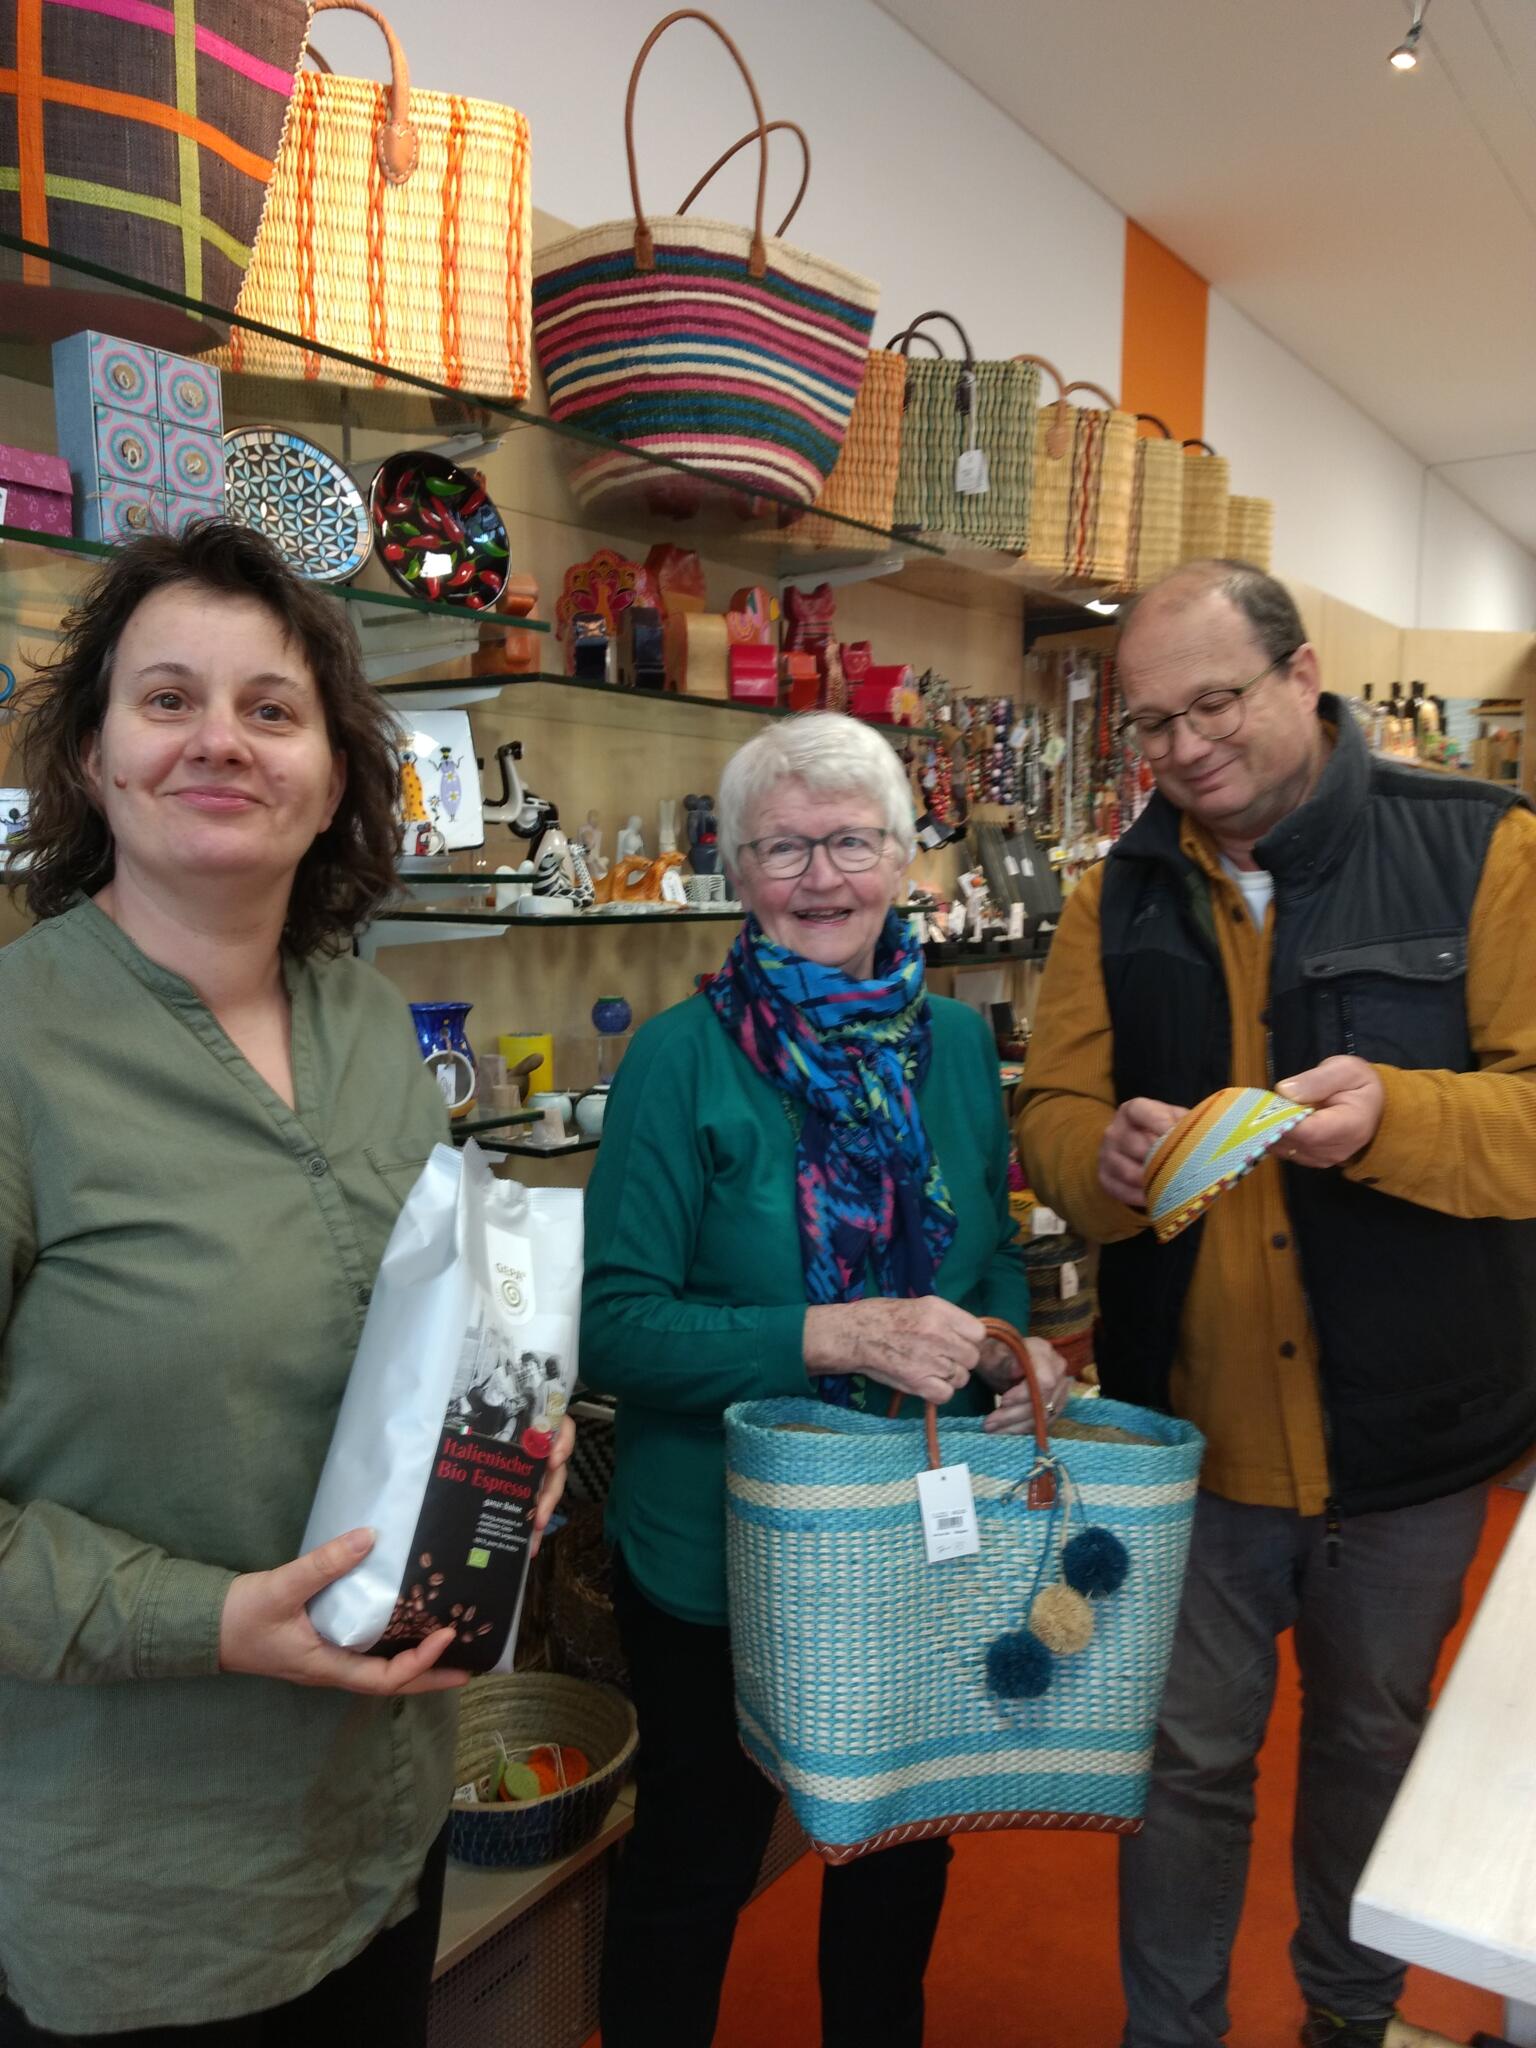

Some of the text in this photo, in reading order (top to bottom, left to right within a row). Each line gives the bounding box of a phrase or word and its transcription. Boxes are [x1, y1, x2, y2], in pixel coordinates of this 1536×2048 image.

[443, 1438, 534, 1476] Italienischer
[437, 1461, 531, 1498] Bio Espresso
